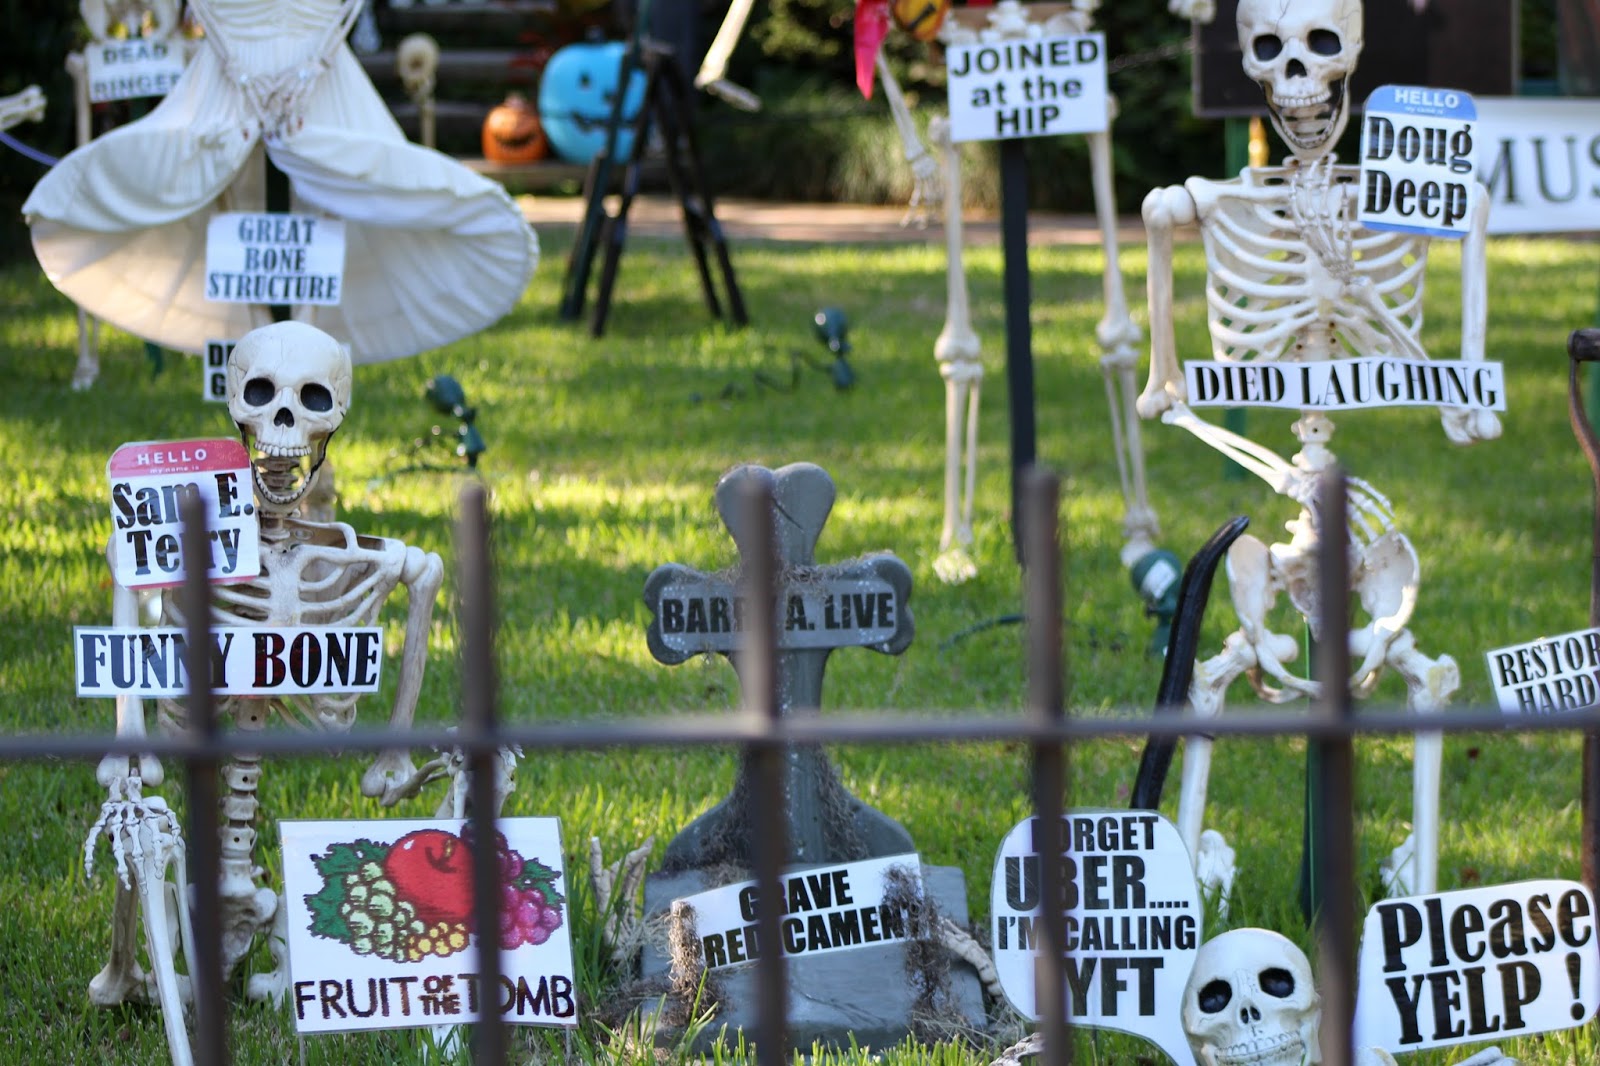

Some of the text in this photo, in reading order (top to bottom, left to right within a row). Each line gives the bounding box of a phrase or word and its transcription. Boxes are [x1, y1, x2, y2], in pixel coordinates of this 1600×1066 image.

[103, 43, 168, 64] DEAD
[952, 39, 1098, 77] JOINED
[971, 75, 1082, 107] at the
[1394, 88, 1459, 109] HELLO
[996, 105, 1060, 135] HIP
[1366, 116, 1473, 174] Doug
[1363, 169, 1468, 227] Deep
[238, 217, 315, 243] GREAT
[243, 247, 306, 272] BONE
[208, 272, 338, 299] STRUCTURE
[1192, 361, 1497, 407] DIED LAUGHING
[137, 448, 207, 466] HELLO
[112, 472, 254, 530] Sam E.
[785, 594, 815, 631] A.
[824, 593, 895, 630] LIVE
[252, 632, 379, 688] BONE
[1058, 914, 1196, 951] CALLING
[1376, 889, 1591, 973] Please
[294, 976, 418, 1019] FRUIT
[423, 974, 454, 994] OF
[1385, 952, 1585, 1045] YELP !
[418, 993, 461, 1015] THE
